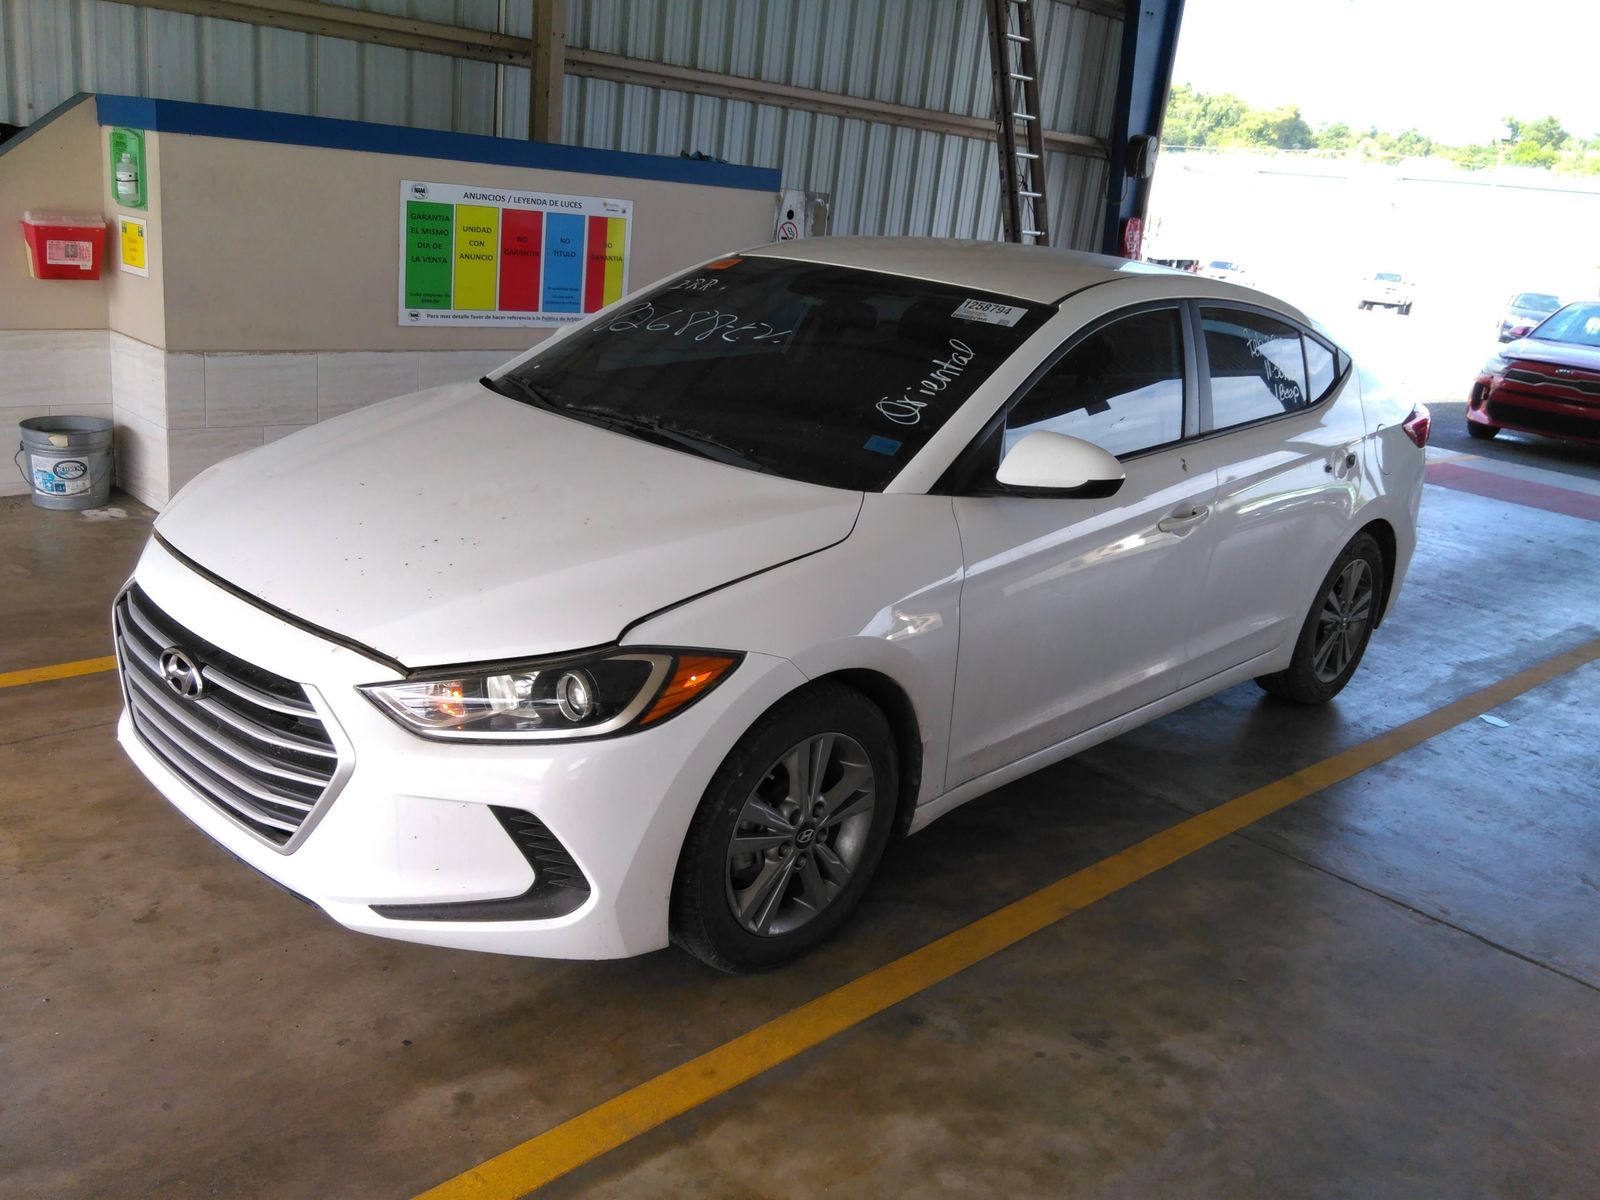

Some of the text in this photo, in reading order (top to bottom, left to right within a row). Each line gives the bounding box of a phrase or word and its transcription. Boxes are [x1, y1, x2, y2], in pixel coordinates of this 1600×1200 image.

[463, 191, 583, 209] ANUNCIOS / LEYENDA DE LUCES
[410, 213, 450, 222] GARANTIA
[421, 228, 449, 236] MISMO
[463, 226, 492, 234] UNIDAD
[559, 237, 571, 245] NO
[459, 253, 494, 261] ANUNCIO
[504, 248, 540, 257] GARANTIA
[553, 249, 577, 258] TITULO
[422, 256, 448, 264] VENTA
[963, 300, 1013, 315] 1258794
[875, 338, 976, 425] Oriental
